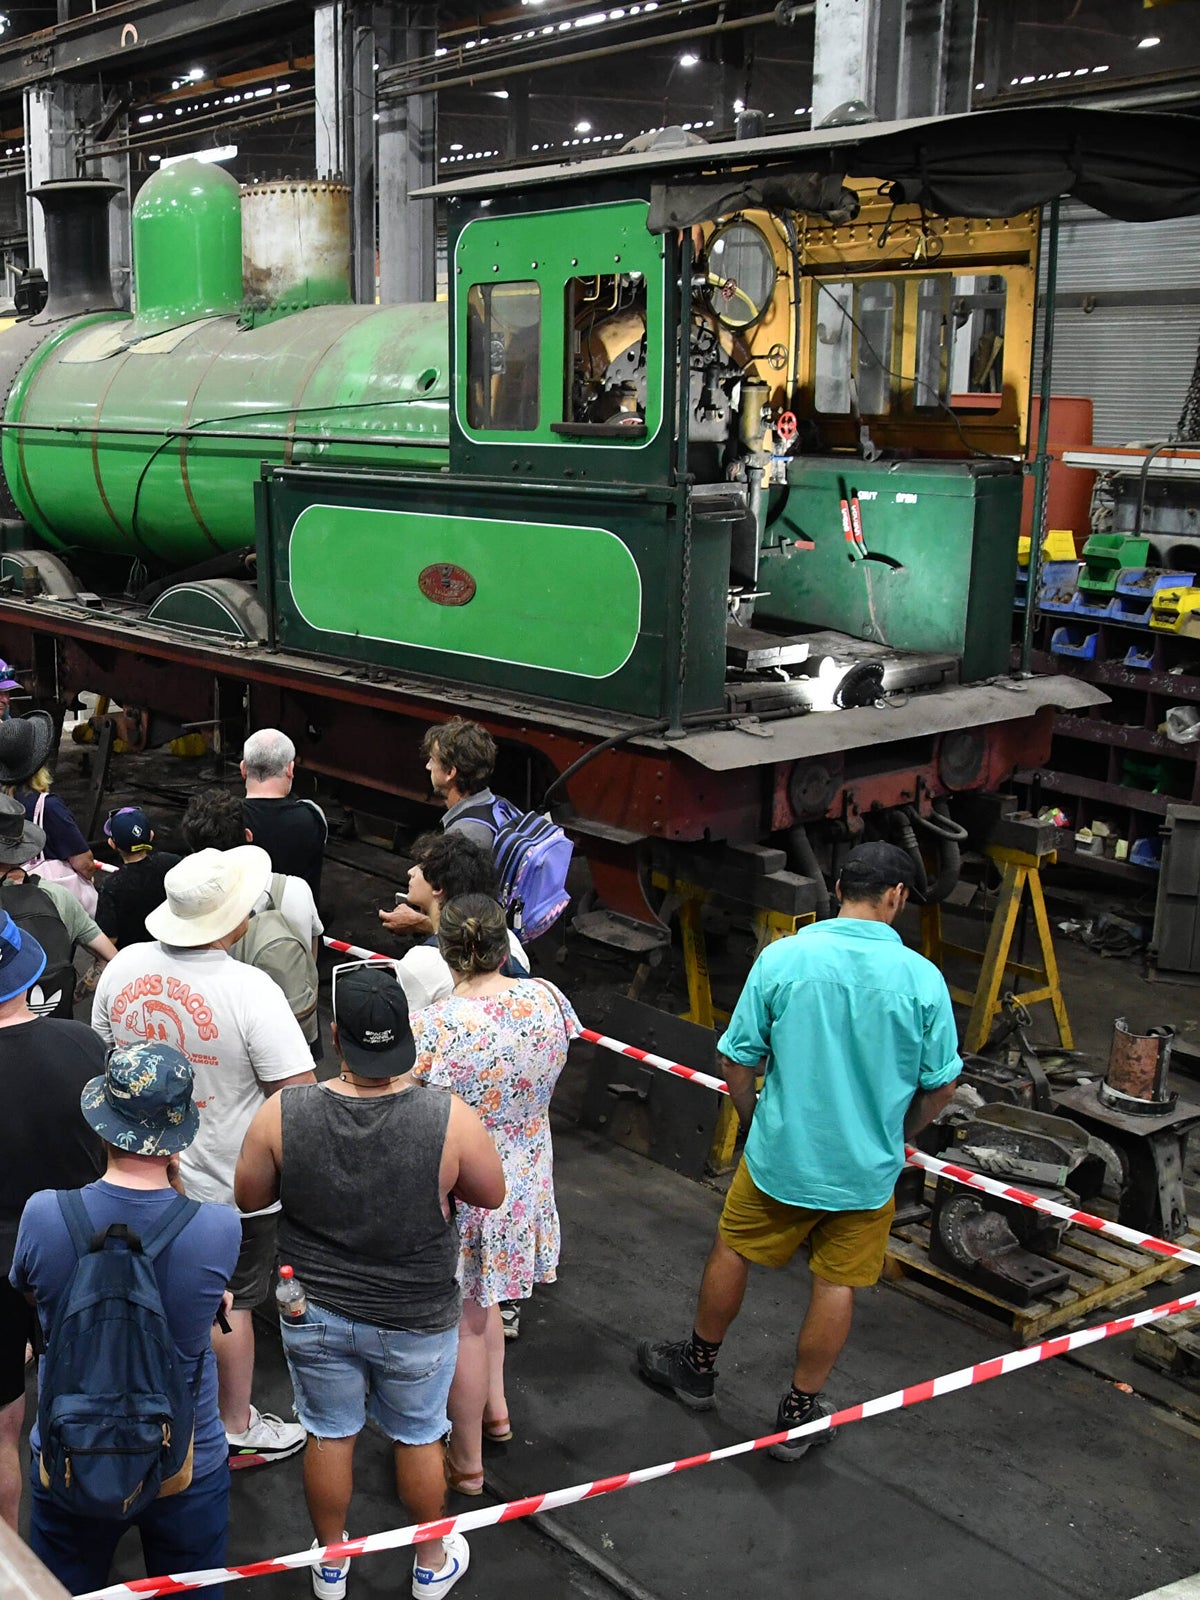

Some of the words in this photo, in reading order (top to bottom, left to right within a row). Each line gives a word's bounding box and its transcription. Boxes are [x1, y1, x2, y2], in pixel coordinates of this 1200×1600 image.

[166, 976, 219, 1041] TACOS
[189, 1057, 219, 1066] FAMOUS
[191, 1053, 217, 1061] WORLD
[417, 1571, 430, 1580] NIKE
